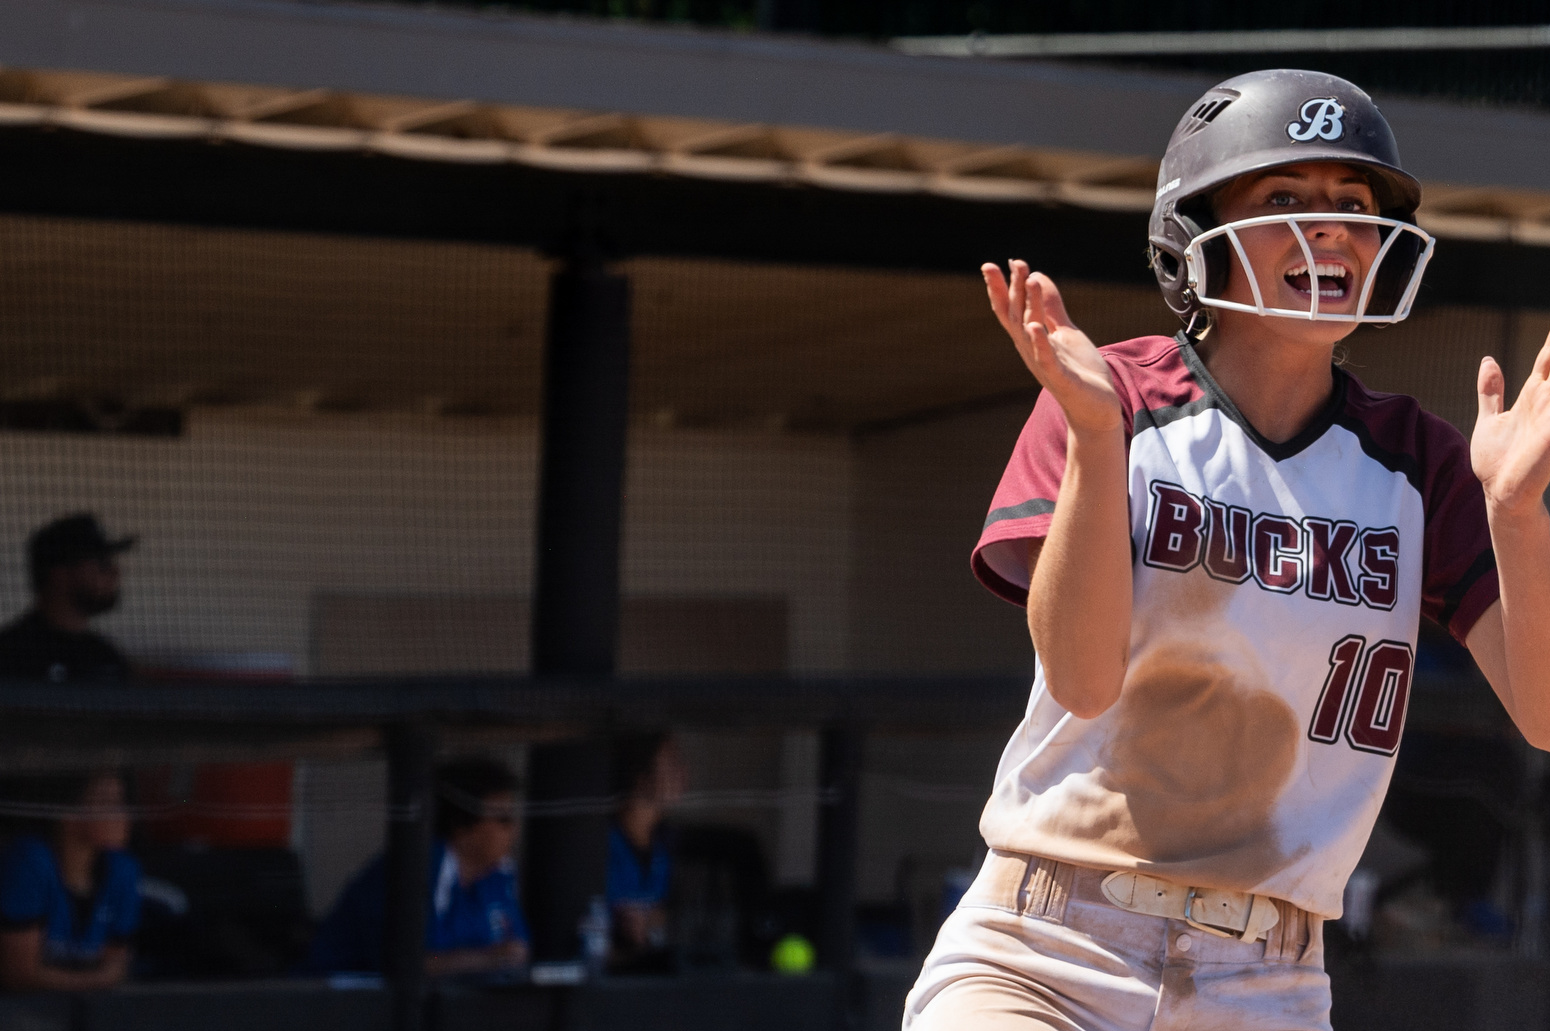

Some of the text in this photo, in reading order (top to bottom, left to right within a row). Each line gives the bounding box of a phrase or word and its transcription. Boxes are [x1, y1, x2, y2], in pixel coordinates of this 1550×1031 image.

[1286, 97, 1345, 143] B
[1143, 479, 1400, 612] BUCKS
[1308, 634, 1414, 758] 10
